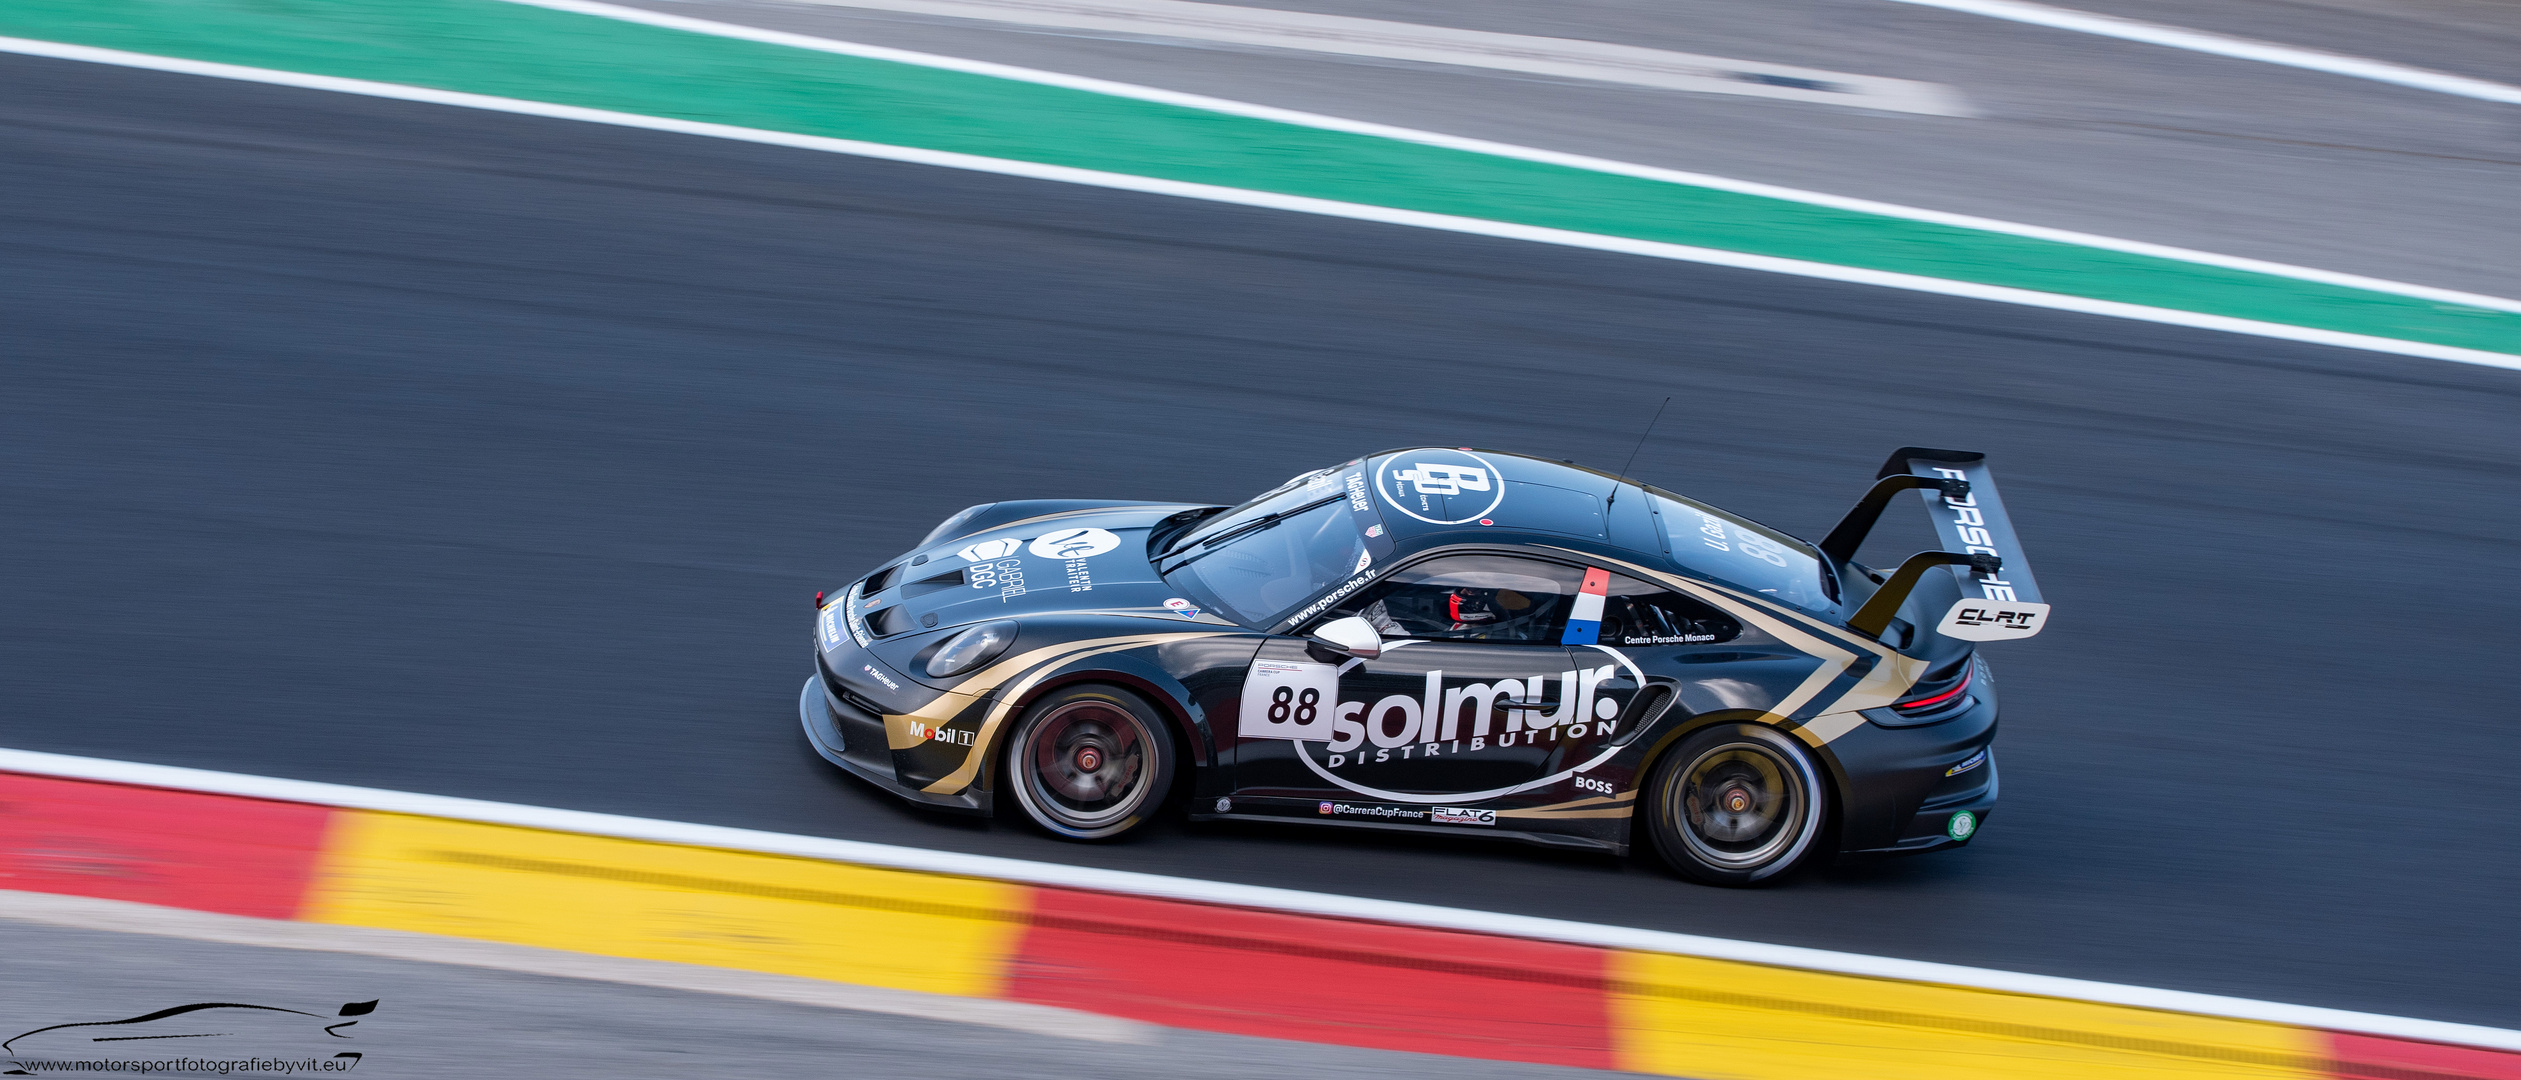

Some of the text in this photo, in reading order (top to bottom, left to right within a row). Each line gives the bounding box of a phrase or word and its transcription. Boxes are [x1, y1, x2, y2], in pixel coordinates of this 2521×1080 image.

[1345, 471, 1369, 512] TAGHeuer
[1703, 537, 1730, 552] U.
[1734, 529, 1787, 568] 88
[969, 563, 997, 589] DGC
[996, 559, 1026, 603] GABRIEL
[1287, 568, 1377, 627] www.porsche.fr
[825, 612, 840, 644] MICHELIN
[1957, 608, 2036, 624] CLRT
[1624, 633, 1715, 645] Centre Porsche Monaco
[869, 668, 899, 691] TAGHeuer
[1268, 686, 1320, 726] 88
[1326, 665, 1619, 753] solmur.
[909, 720, 956, 744] Mobil
[1327, 719, 1619, 769] DISTRIBUTION
[1575, 776, 1614, 795] BOSS
[1333, 804, 1424, 819] @CarreraCupFrance
[1433, 807, 1495, 822] FLAT 6
